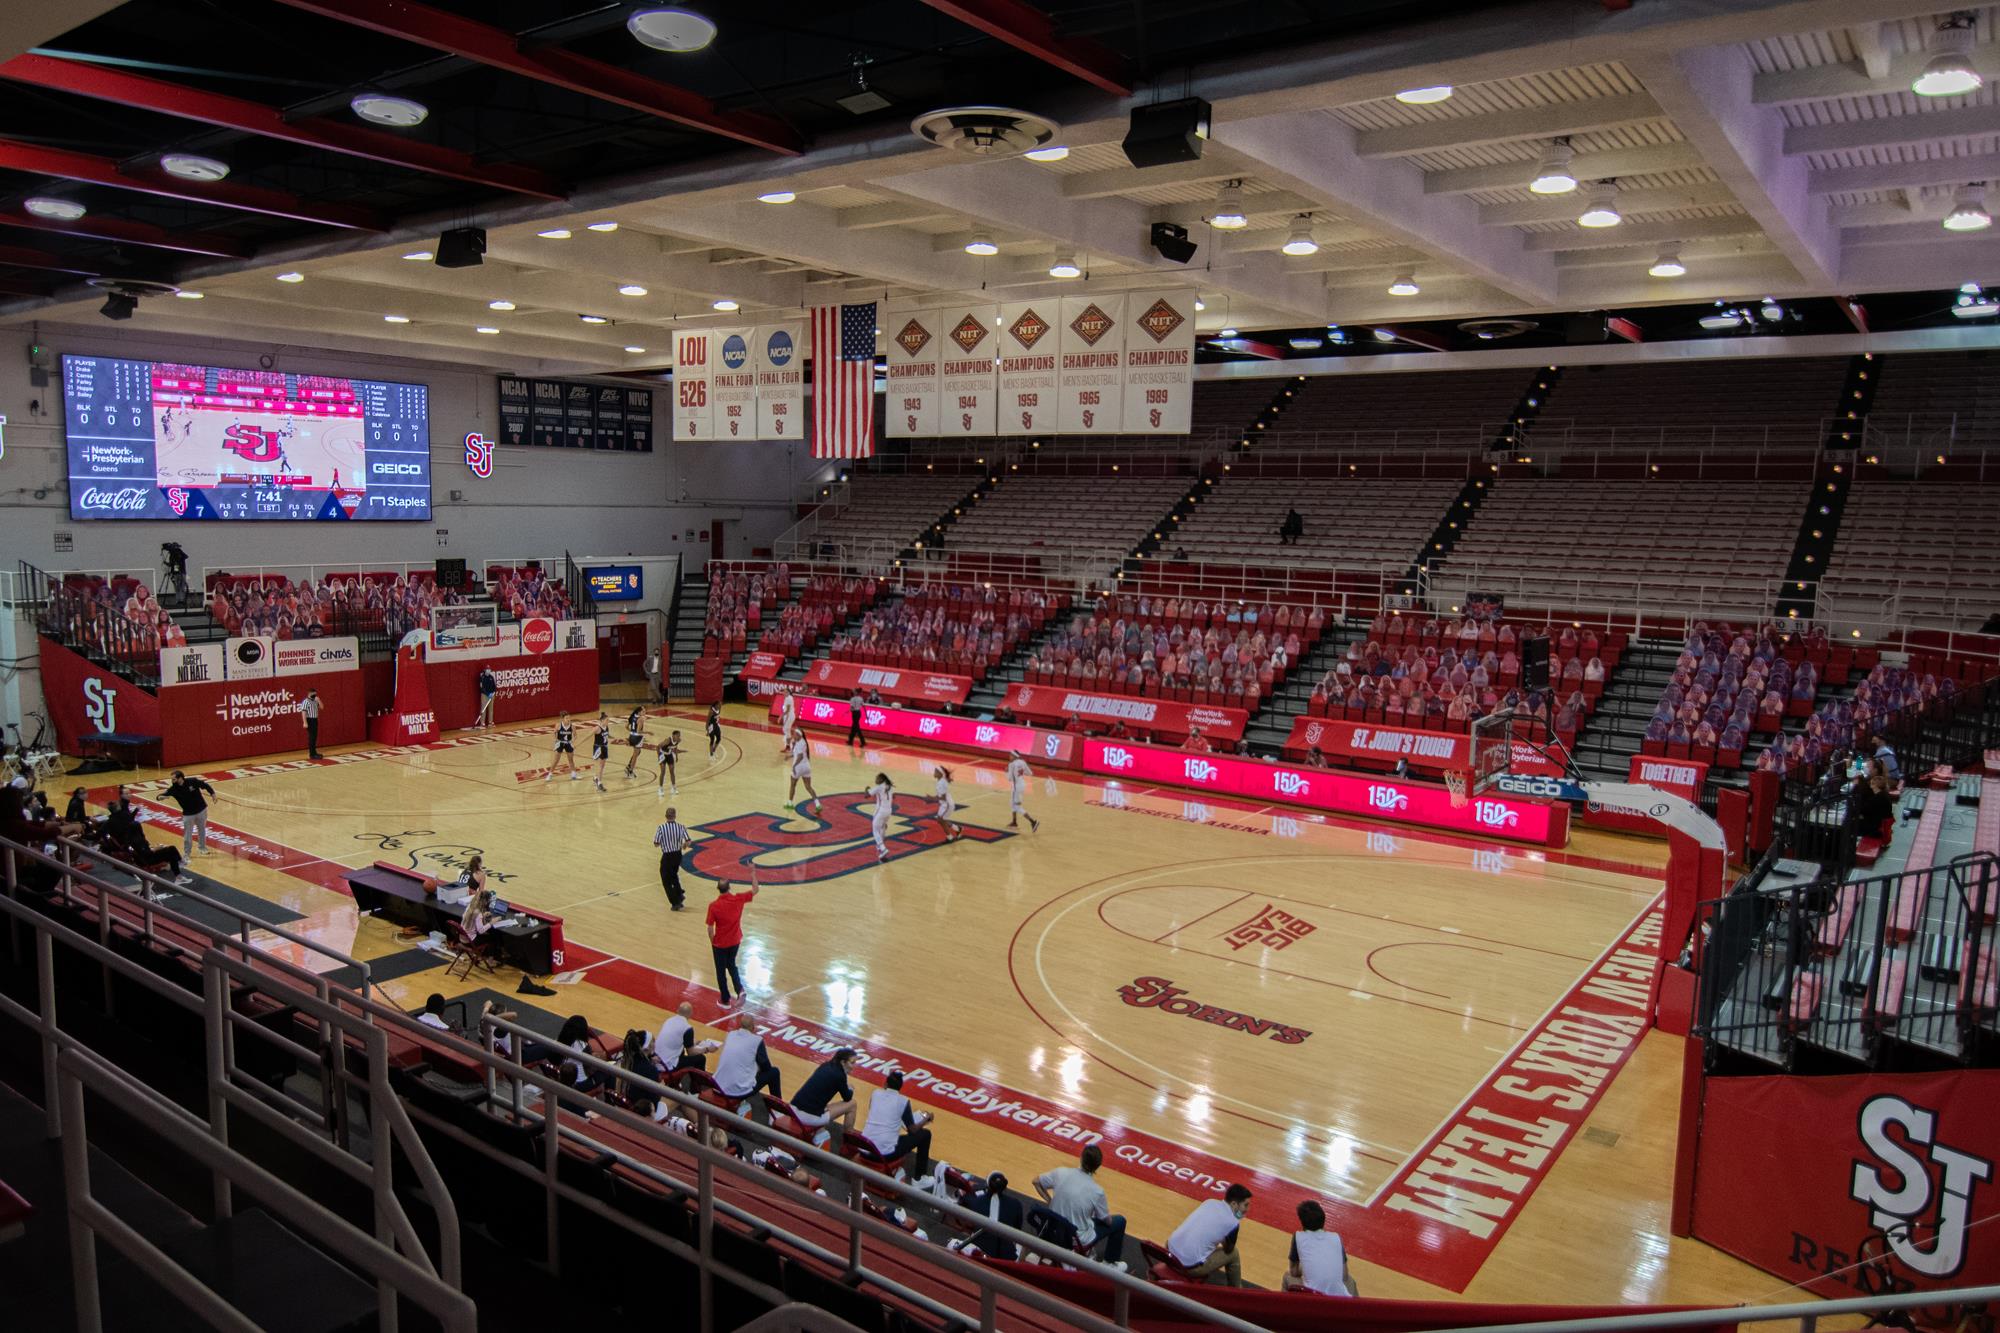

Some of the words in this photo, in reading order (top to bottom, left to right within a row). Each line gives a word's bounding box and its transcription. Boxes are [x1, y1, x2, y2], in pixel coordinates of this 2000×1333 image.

[1081, 320, 1104, 331] NIT
[1149, 316, 1173, 327] NIT
[959, 329, 980, 340] NIT
[1019, 325, 1039, 335] NIT
[904, 333, 923, 343] NIT
[679, 336, 707, 367] LOU
[724, 350, 747, 361] NCAA
[769, 346, 793, 357] NCAA
[1128, 349, 1188, 366] CHAMPIONS
[944, 360, 992, 375] CHAMPIONS
[1002, 356, 1054, 372] CHAMPIONS
[1063, 352, 1118, 369] CHAMPIONS
[760, 372, 779, 384] FINAL
[781, 371, 800, 383] FOUR
[890, 363, 935, 378] CHAMPIONS
[716, 376, 734, 387] FINAL
[736, 374, 753, 386] FOUR
[501, 380, 528, 397] NCAA
[535, 383, 560, 399] NCAA
[680, 380, 706, 408] 526
[903, 398, 921, 410] 1943
[958, 396, 976, 408] 1944
[1017, 393, 1038, 406] 1959
[1078, 391, 1100, 405] 1965
[1146, 390, 1168, 404] 1989
[727, 405, 741, 417] 1952
[772, 403, 787, 415] 1985
[80, 413, 88, 424] 0
[107, 415, 115, 426] 0
[133, 417, 141, 427] 0
[374, 431, 380, 440] 0
[394, 432, 400, 441] 0
[412, 433, 417, 442] 1
[92, 455, 144, 465] Presbyterian
[92, 465, 118, 473] Queens
[373, 463, 422, 475] GEICO
[255, 491, 282, 502] 7:41
[195, 506, 204, 517] 7
[223, 510, 229, 518] 0
[329, 507, 337, 517] 4
[182, 654, 202, 665] ACCEPT
[278, 649, 315, 659] JOHNNIES
[278, 658, 298, 667] WORK
[177, 666, 188, 682] NO
[496, 677, 529, 688] SAVINGS
[529, 675, 550, 685] BANK
[231, 689, 294, 706] NewYork-
[231, 702, 303, 721] Presbyteria
[814, 702, 831, 718] 150
[401, 712, 434, 724] MUSCLE
[232, 724, 272, 736] Queens
[408, 723, 430, 735] MILK
[919, 717, 937, 734] 150
[976, 726, 993, 742] 150
[1368, 730, 1413, 753] JOHN'S
[1413, 734, 1455, 759] TOUGH
[1103, 746, 1127, 768] 150
[1184, 758, 1209, 780] 150
[1639, 762, 1697, 786] TOGETHER
[1273, 771, 1300, 794] 150
[1499, 778, 1562, 796] GEICO
[1368, 785, 1398, 808] 150
[1475, 800, 1507, 827] 150
[1202, 819, 1270, 836] ARENA
[1223, 908, 1296, 952] EAST
[1259, 917, 1318, 951] BIG
[1580, 948, 1659, 1012] NEW
[1491, 1005, 1648, 1112] YORK'S
[1115, 1143, 1231, 1194] Queens
[1384, 1105, 1570, 1241] TEAM
